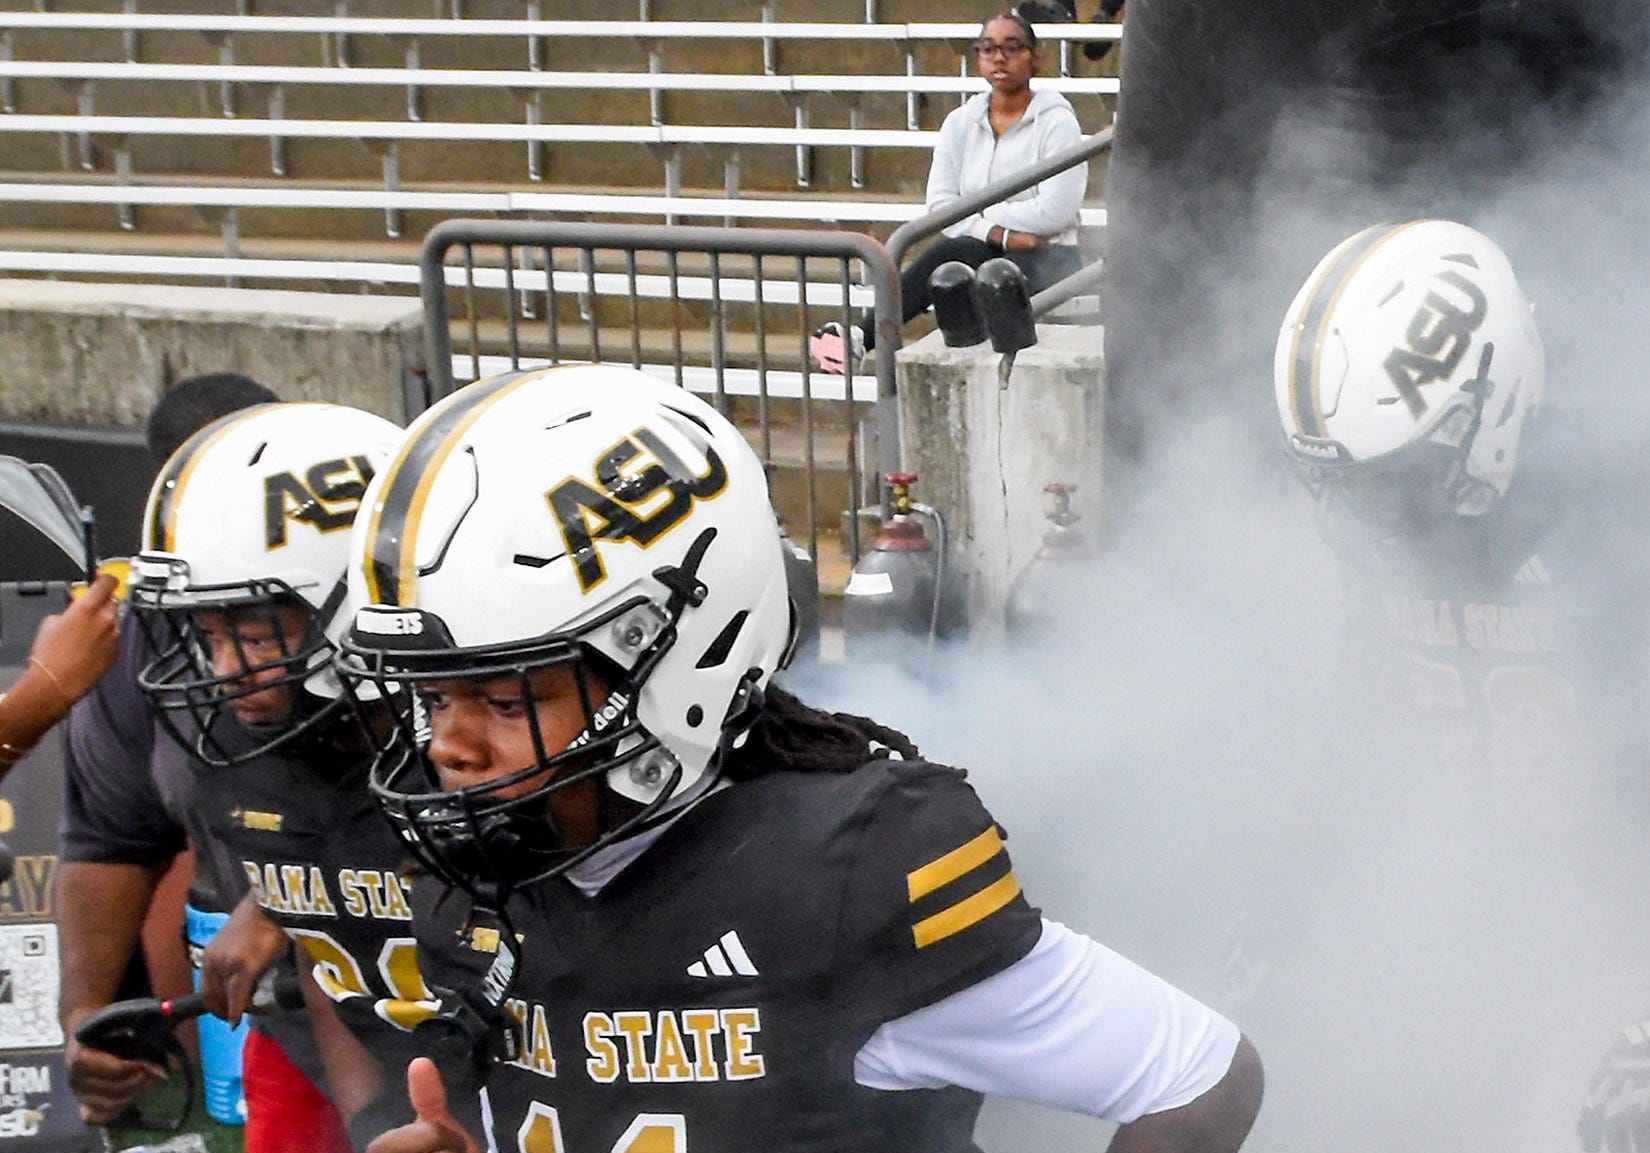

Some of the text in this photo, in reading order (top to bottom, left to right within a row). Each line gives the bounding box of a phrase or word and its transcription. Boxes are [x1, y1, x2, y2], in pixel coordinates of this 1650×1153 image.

[1380, 269, 1489, 422] ASU
[545, 425, 730, 597] ASU
[338, 868, 414, 922] STA
[583, 1007, 766, 1084] STATE
